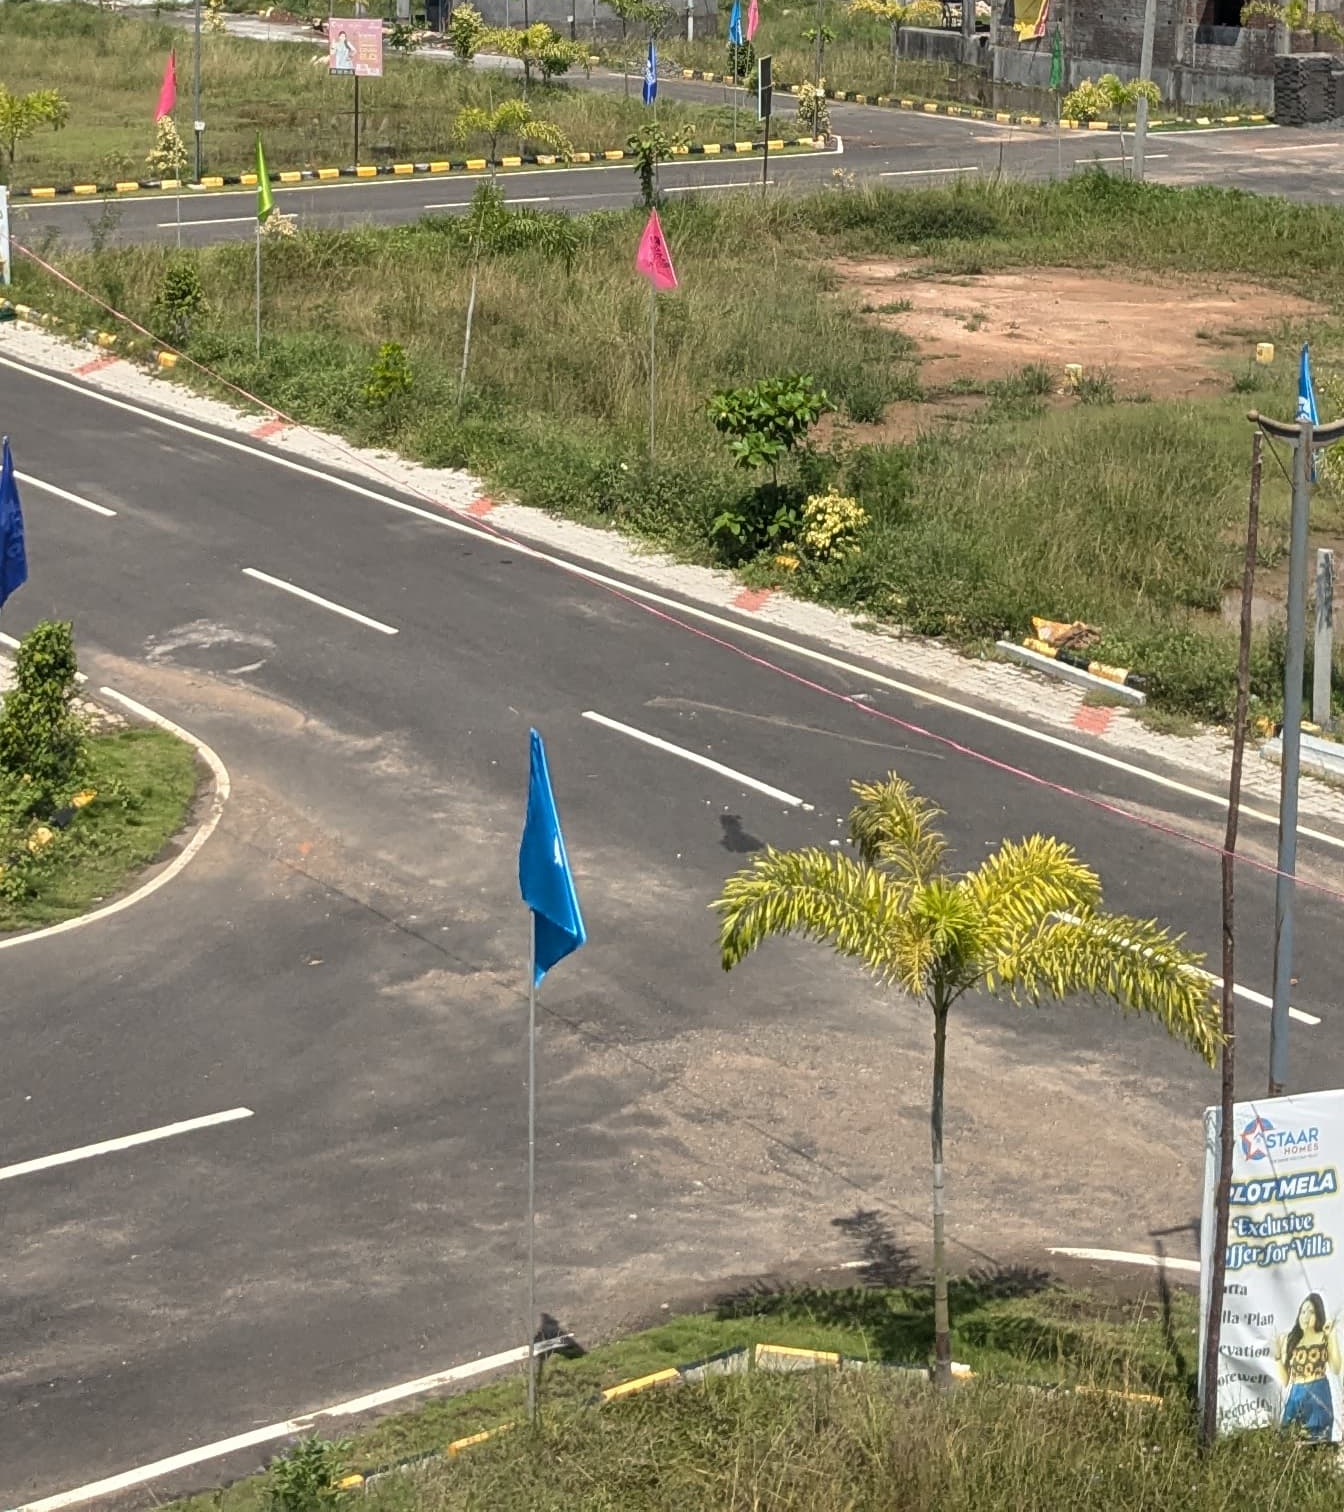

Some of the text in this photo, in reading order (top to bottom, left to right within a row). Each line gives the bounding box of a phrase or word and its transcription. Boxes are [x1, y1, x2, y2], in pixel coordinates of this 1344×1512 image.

[1266, 1127, 1319, 1149] STAAR
[1283, 1143, 1320, 1156] HOMES
[1278, 1171, 1334, 1199] MELA
[1233, 1215, 1313, 1237] Exclusive
[1224, 1233, 1332, 1269] ffer for Villa
[1222, 1309, 1274, 1326] lla Plan
[1218, 1343, 1271, 1359] evation
[1217, 1371, 1268, 1386] orewell
